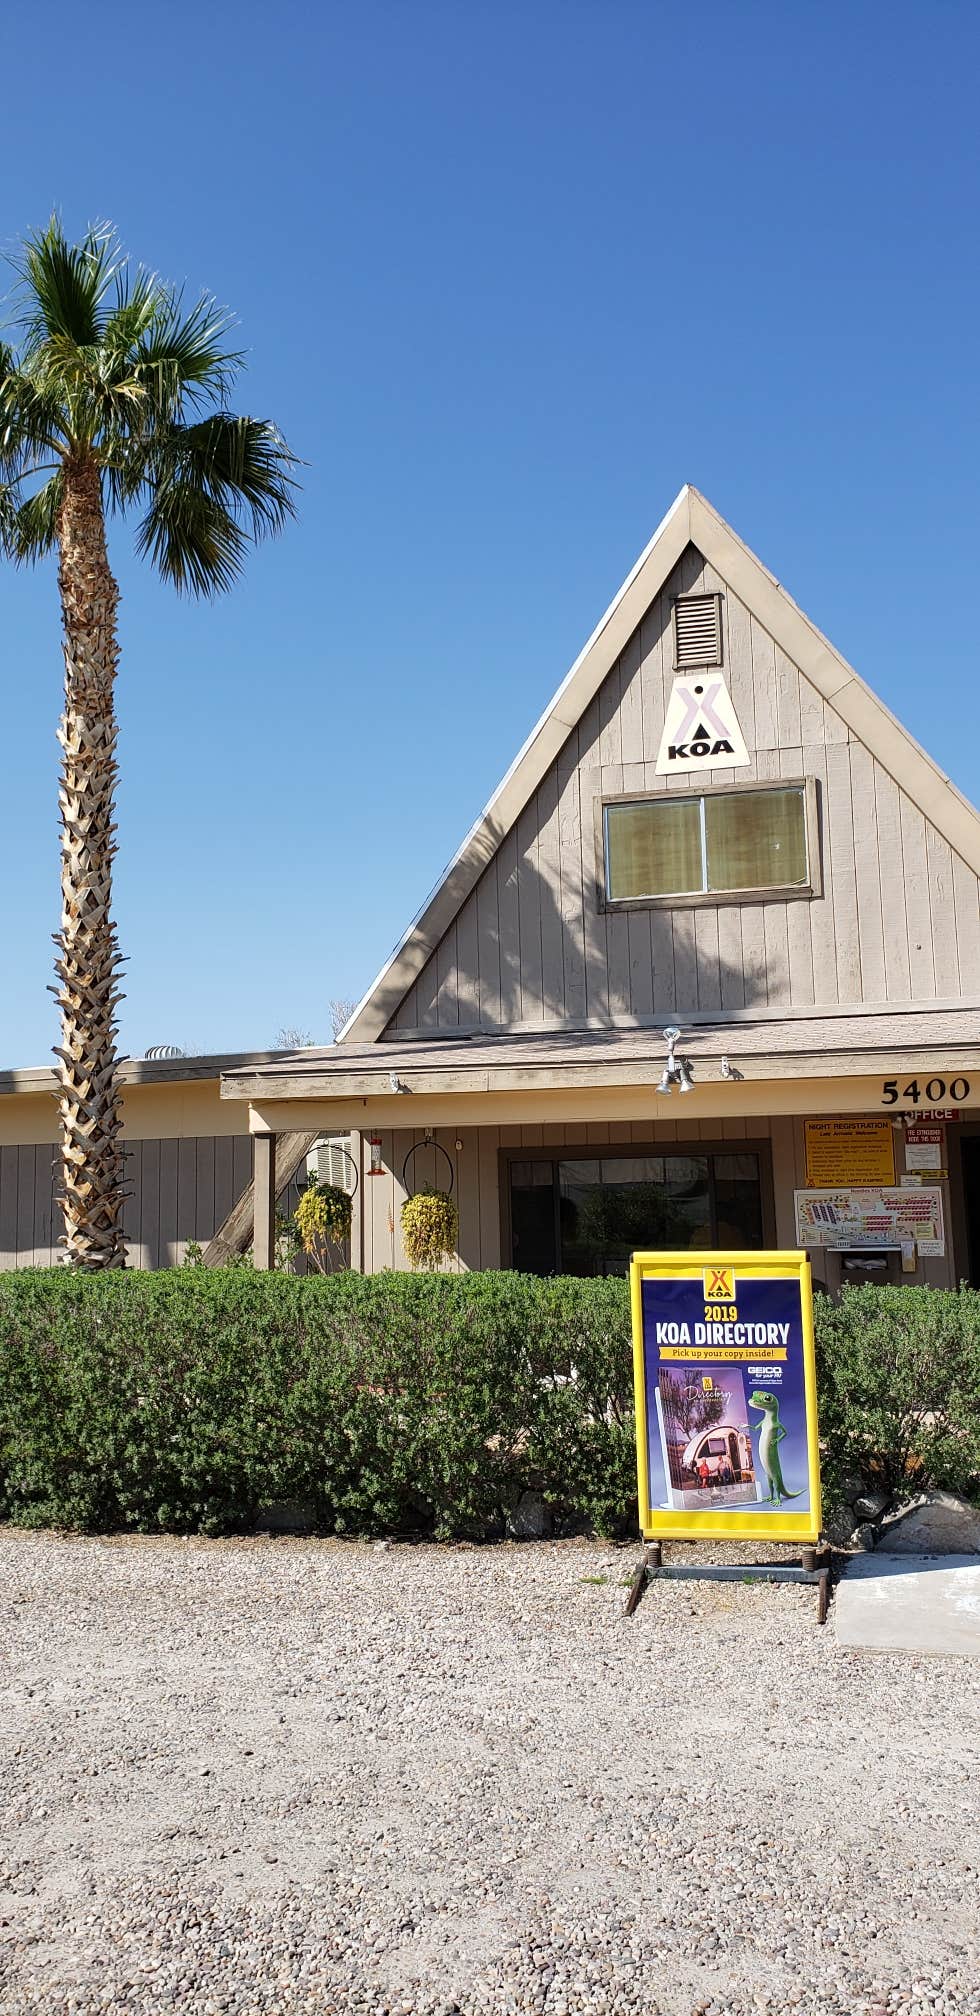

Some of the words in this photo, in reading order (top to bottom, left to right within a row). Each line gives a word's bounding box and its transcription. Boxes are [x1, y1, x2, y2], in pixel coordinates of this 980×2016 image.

[668, 740, 735, 760] KOA
[881, 1078, 970, 1104] 5400
[833, 1121, 889, 1130] REGISTRATION
[704, 1306, 738, 1321] 2019
[656, 1322, 691, 1344] KOA
[694, 1322, 790, 1345] DIRECTORY
[672, 1349, 689, 1357] Pick
[703, 1351, 722, 1359] your
[724, 1351, 744, 1359] copy
[745, 1349, 775, 1357] inside!
[747, 1366, 784, 1374] GEICO
[683, 1385, 733, 1405] Directory
